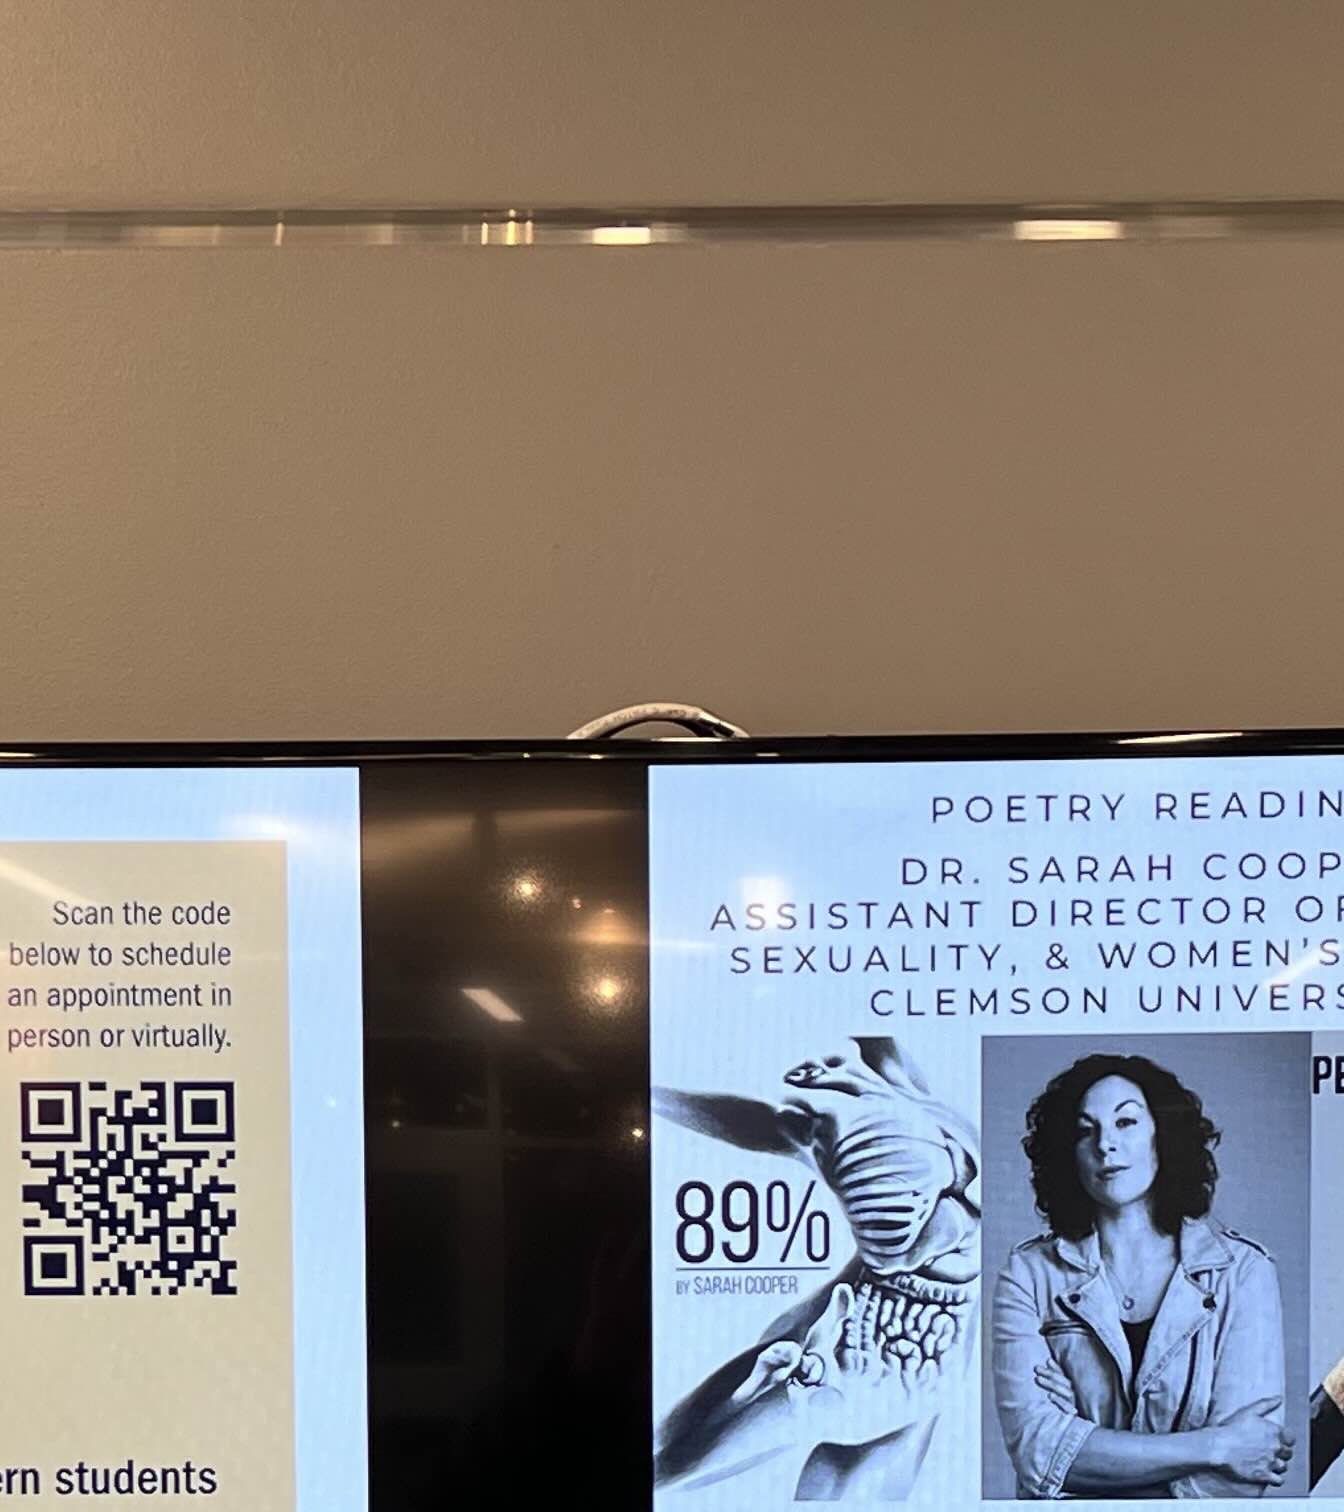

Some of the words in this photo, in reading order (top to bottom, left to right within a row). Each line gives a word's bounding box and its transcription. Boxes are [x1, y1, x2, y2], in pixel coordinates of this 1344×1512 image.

[933, 794, 1124, 823] POETRY
[902, 858, 979, 885] DR.
[1009, 855, 1171, 883] SARAH
[53, 902, 113, 925] Scan
[123, 901, 162, 925] the
[172, 901, 230, 925] code
[710, 901, 981, 930] ASSISTANT
[1013, 897, 1265, 927] DIRECTOR
[10, 942, 80, 966] below
[88, 943, 112, 966] to
[122, 942, 231, 966] schedule
[731, 944, 1016, 975] SEXUALITY,
[1046, 943, 1069, 969] &
[1098, 938, 1339, 969] WOMEN'S
[8, 988, 37, 1006] an
[47, 983, 202, 1012] appointment
[212, 982, 231, 1006] in
[871, 987, 1106, 1016] CLEMSON
[8, 1029, 90, 1052] person
[100, 1029, 125, 1047] or
[132, 1024, 231, 1053] virtually.
[675, 1179, 831, 1264] 89%
[676, 1280, 690, 1295] BY
[694, 1276, 741, 1295] SARAH
[745, 1275, 798, 1295] COOPER
[56, 1460, 217, 1495] students
